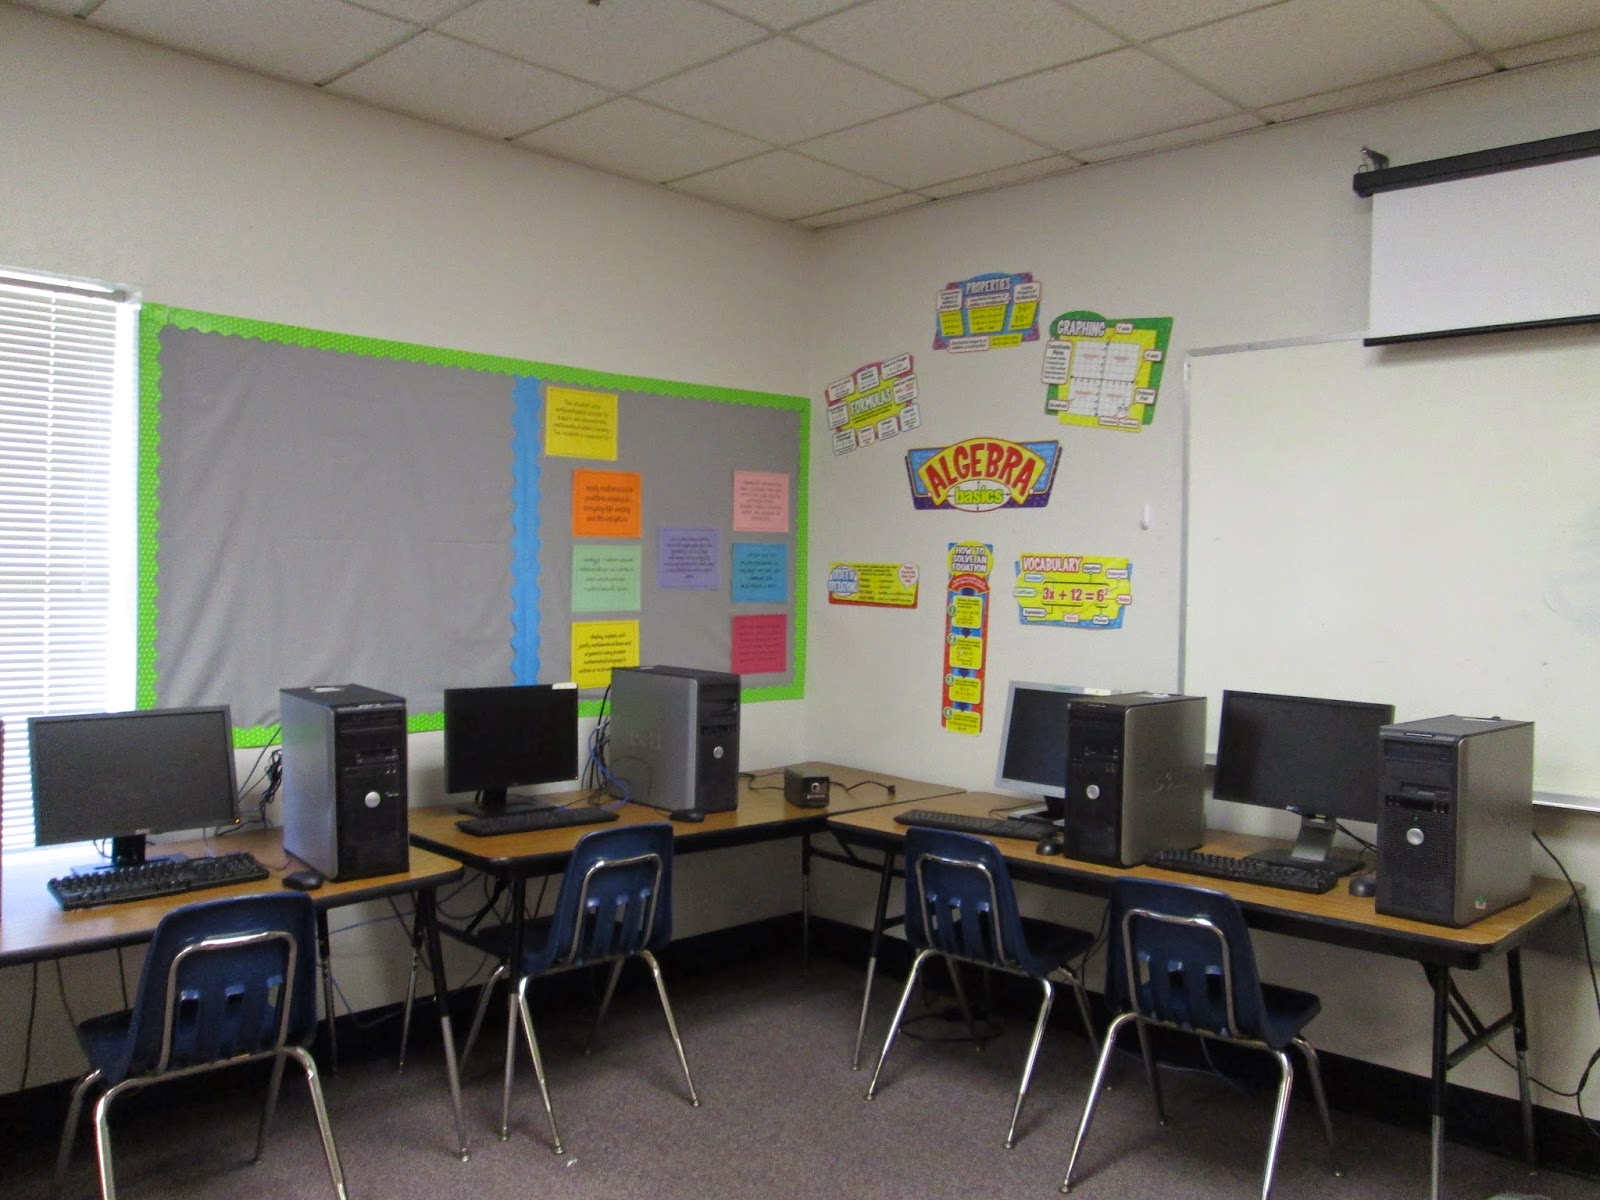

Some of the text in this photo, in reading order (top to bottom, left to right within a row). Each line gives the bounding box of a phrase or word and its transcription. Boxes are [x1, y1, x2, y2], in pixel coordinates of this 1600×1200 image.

[966, 278, 1010, 294] PROPERTIES
[1057, 319, 1107, 338] GRAPHING
[925, 442, 1036, 500] ALGEBRA
[954, 485, 1004, 505] basics
[956, 546, 985, 555] HOW TO
[953, 554, 987, 564] SOLVE AN
[1022, 556, 1082, 573] VOCABULARY
[952, 563, 988, 573] EQUATION
[1042, 587, 1054, 601] 3x
[1070, 588, 1082, 602] 12
